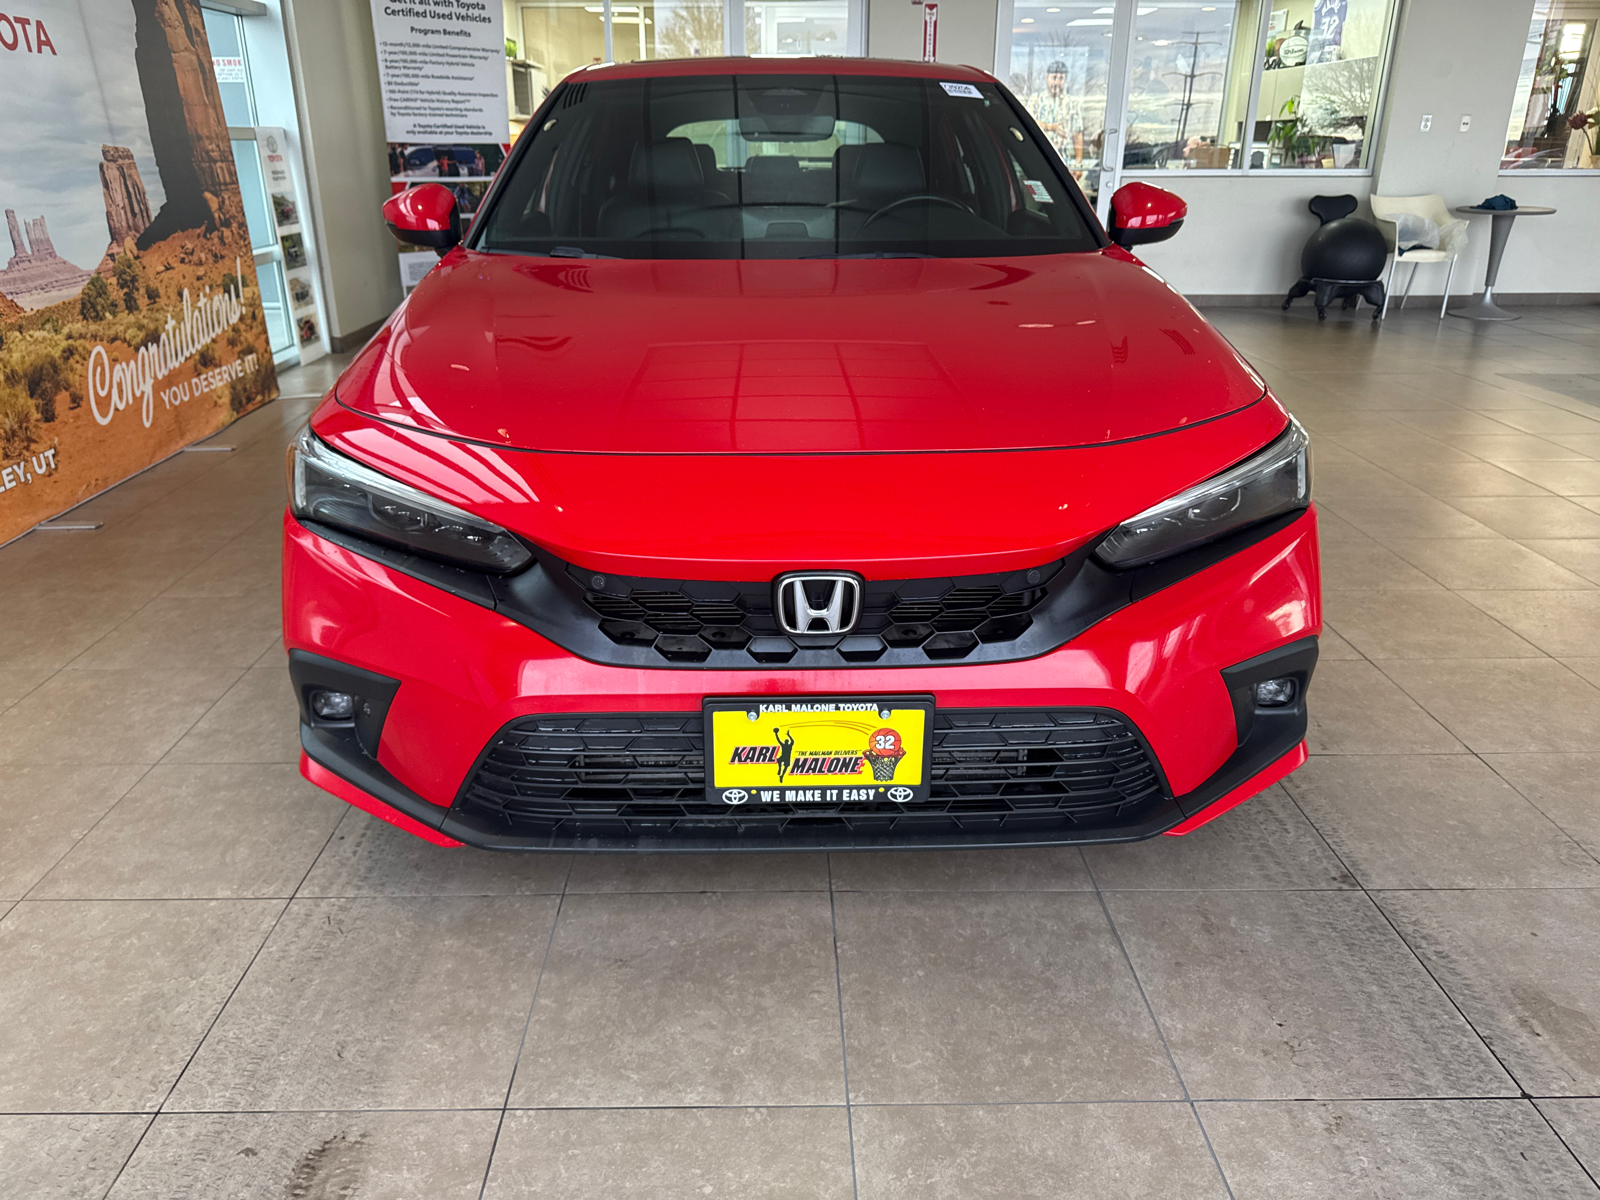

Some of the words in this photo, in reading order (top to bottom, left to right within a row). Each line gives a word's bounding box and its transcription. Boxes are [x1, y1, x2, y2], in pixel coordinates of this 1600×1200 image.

[455, 0, 486, 11] Toyota
[384, 6, 427, 18] Certified
[429, 10, 453, 20] Used
[454, 12, 492, 23] Vehicles
[0, 12, 57, 56] OTA
[410, 26, 441, 36] Program
[442, 28, 471, 37] Benefits
[88, 256, 246, 428] Congratulations!
[160, 382, 190, 409] YOU
[192, 360, 244, 397] DESERVE
[244, 353, 258, 376] IT!
[32, 448, 56, 475] UT
[760, 704, 789, 713] KARL
[791, 704, 836, 712] MALONE
[838, 703, 878, 712] TOYOTA
[875, 735, 895, 750] 32
[728, 746, 780, 764] KARL
[788, 756, 866, 775] MALONE
[760, 790, 780, 802] WE
[785, 790, 821, 802] MAKE
[825, 790, 838, 801] IT
[842, 789, 876, 800] EASY
